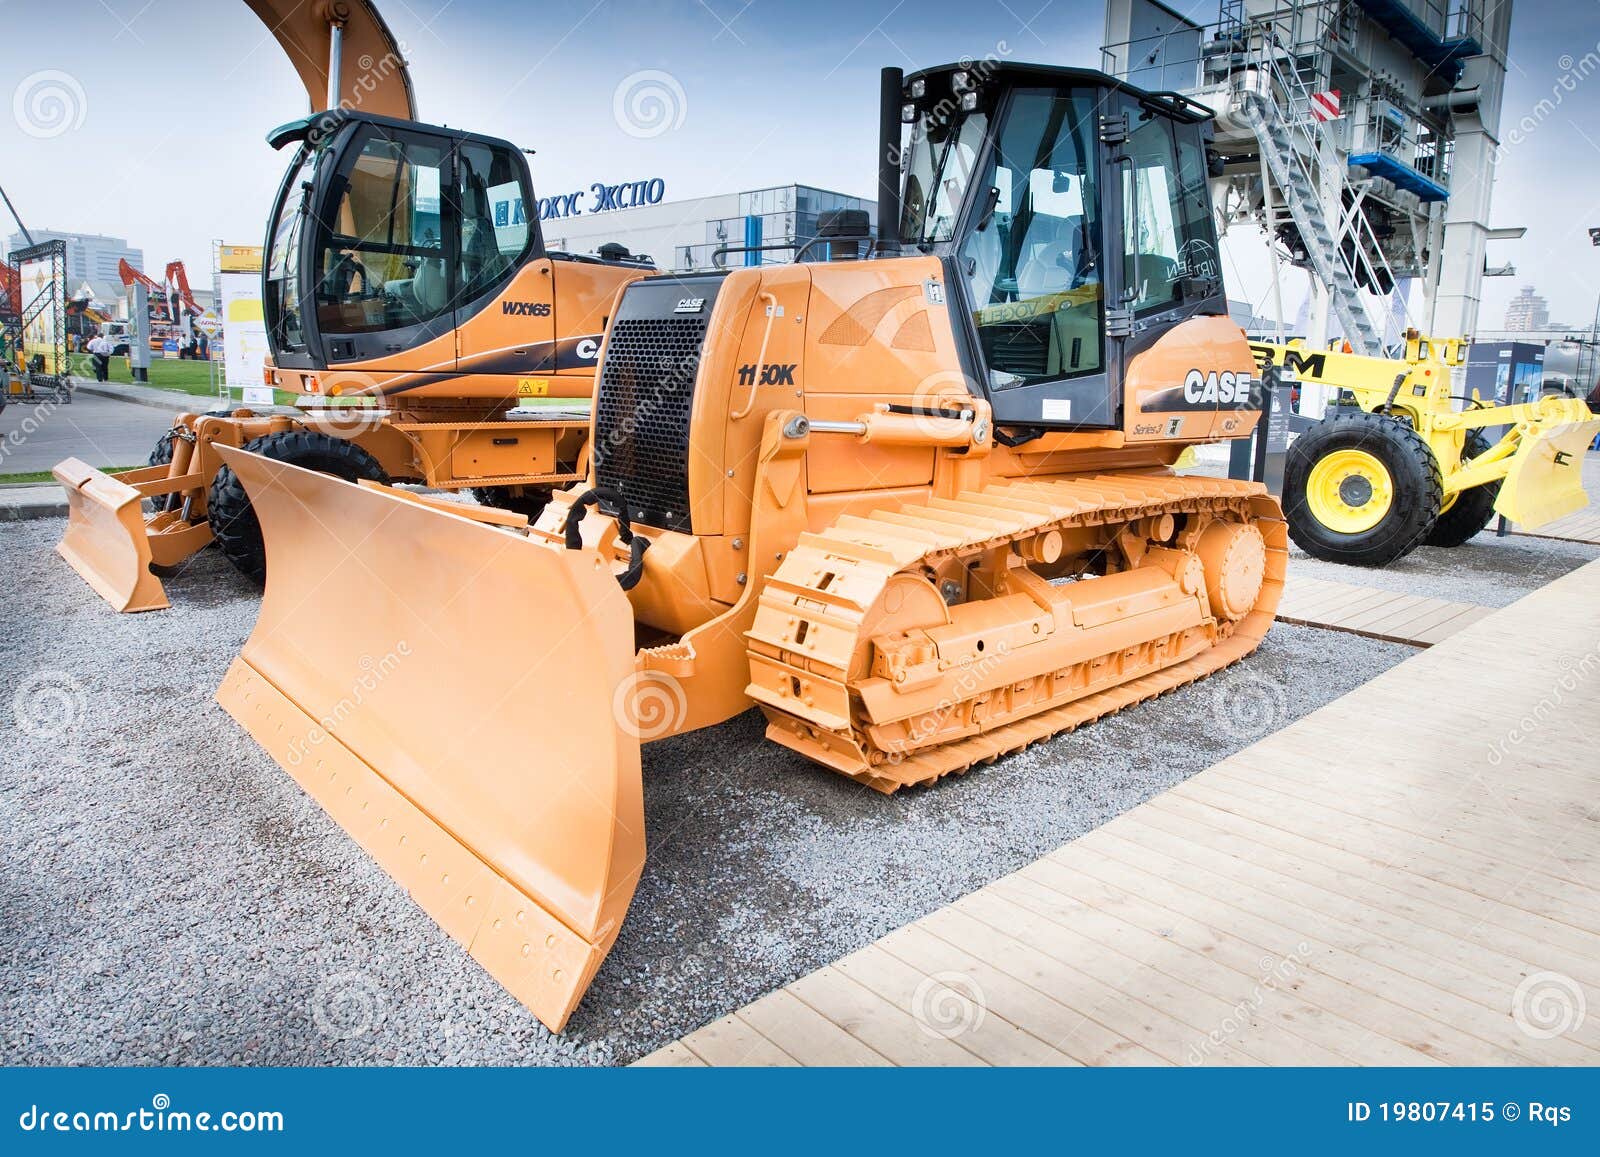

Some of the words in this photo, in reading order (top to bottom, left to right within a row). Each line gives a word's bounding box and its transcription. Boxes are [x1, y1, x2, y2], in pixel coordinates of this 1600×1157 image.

[512, 191, 584, 225] КОКУС
[502, 301, 551, 317] WX165
[677, 298, 705, 308] CASE
[738, 364, 797, 386] 1150K
[1183, 368, 1252, 404] CASE
[1133, 423, 1155, 435] Series
